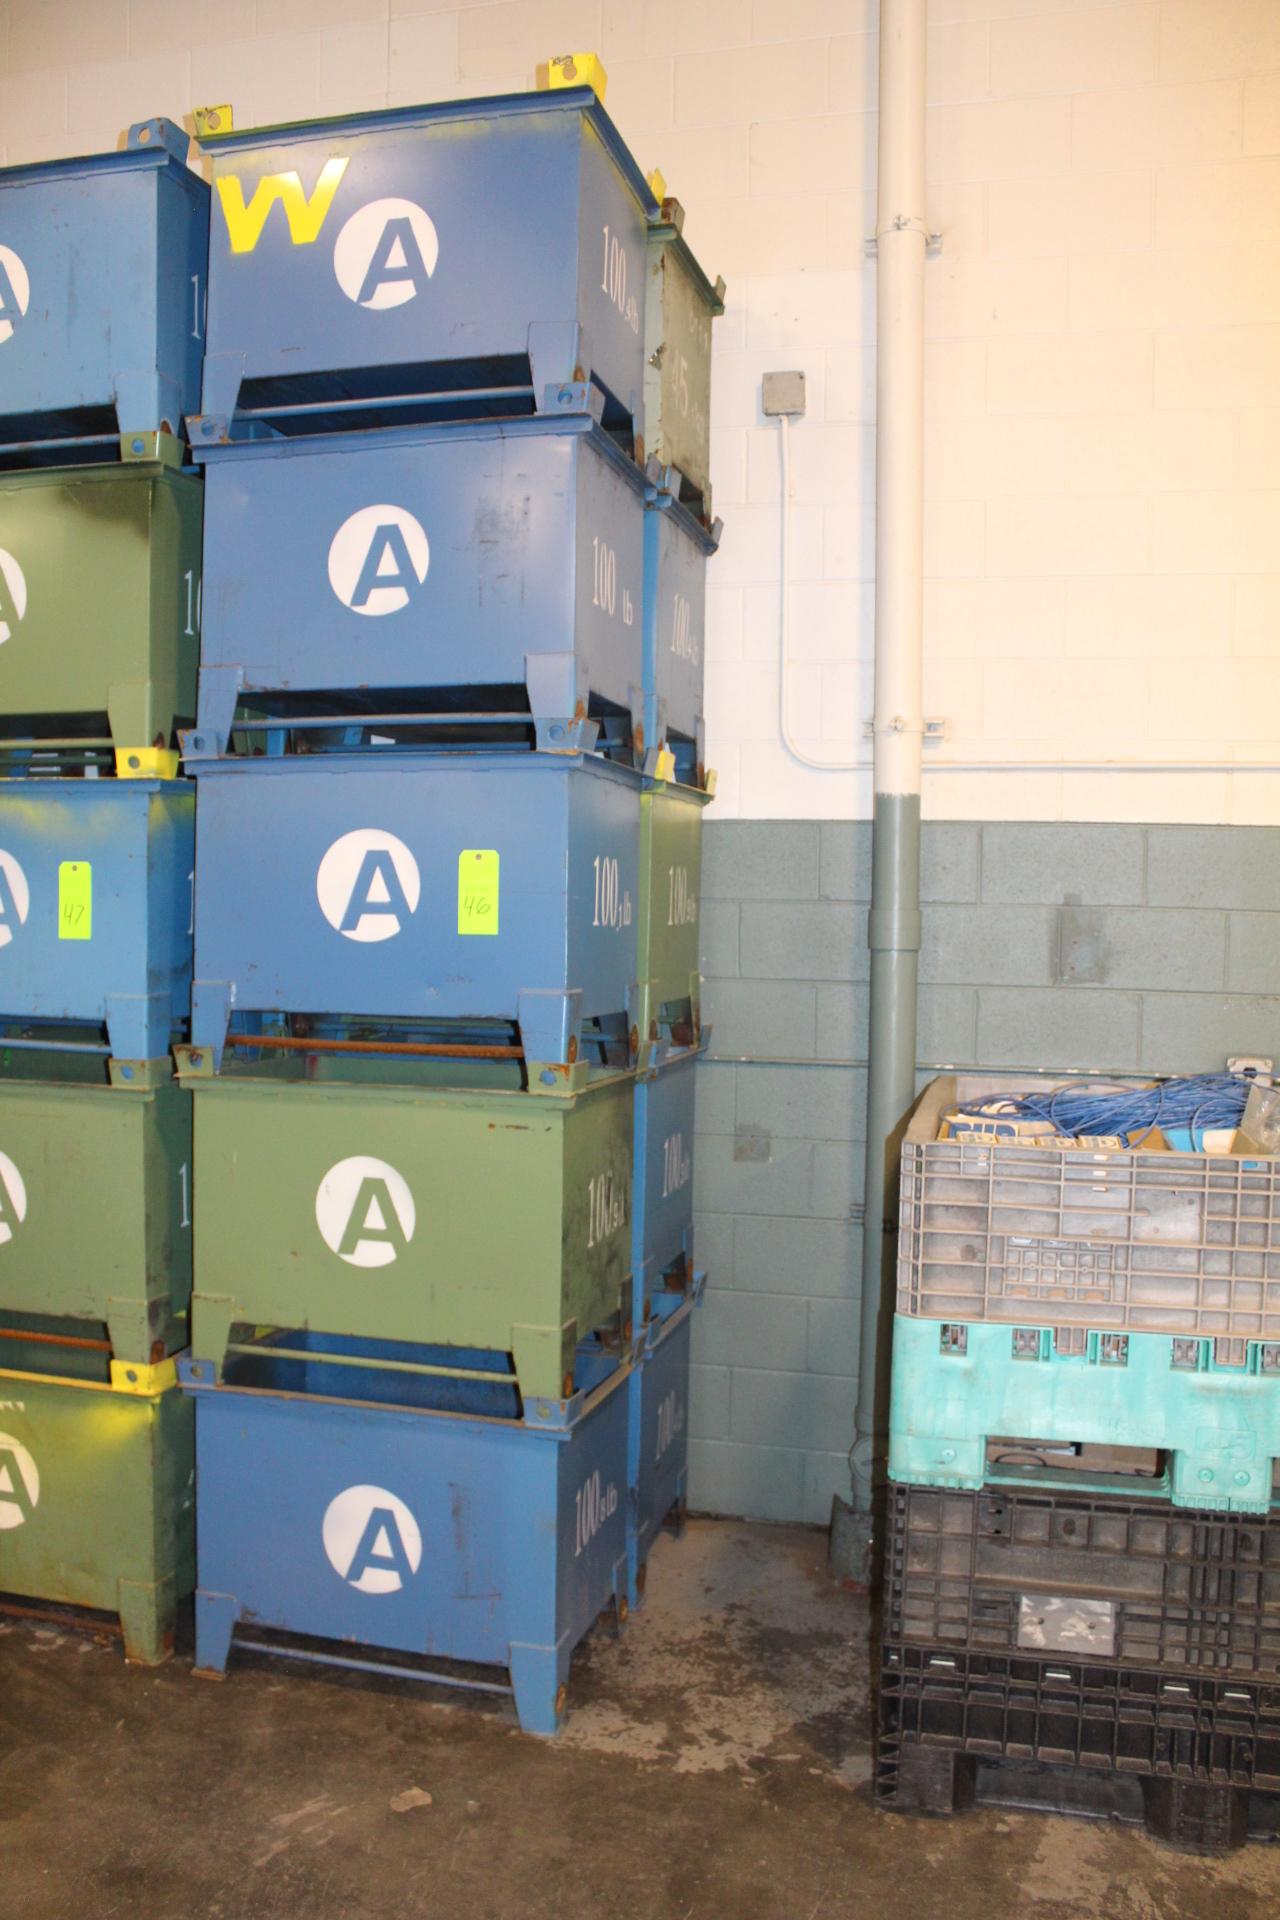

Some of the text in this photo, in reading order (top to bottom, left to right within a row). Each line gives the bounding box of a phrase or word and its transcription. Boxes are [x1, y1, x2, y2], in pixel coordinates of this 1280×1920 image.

[354, 216, 432, 304] A
[349, 523, 423, 607] A
[593, 536, 633, 626] 100 lb
[63, 902, 85, 926] 47
[339, 848, 413, 932] A
[463, 895, 491, 917] 46
[336, 1176, 410, 1256] A
[346, 1506, 415, 1582] A
